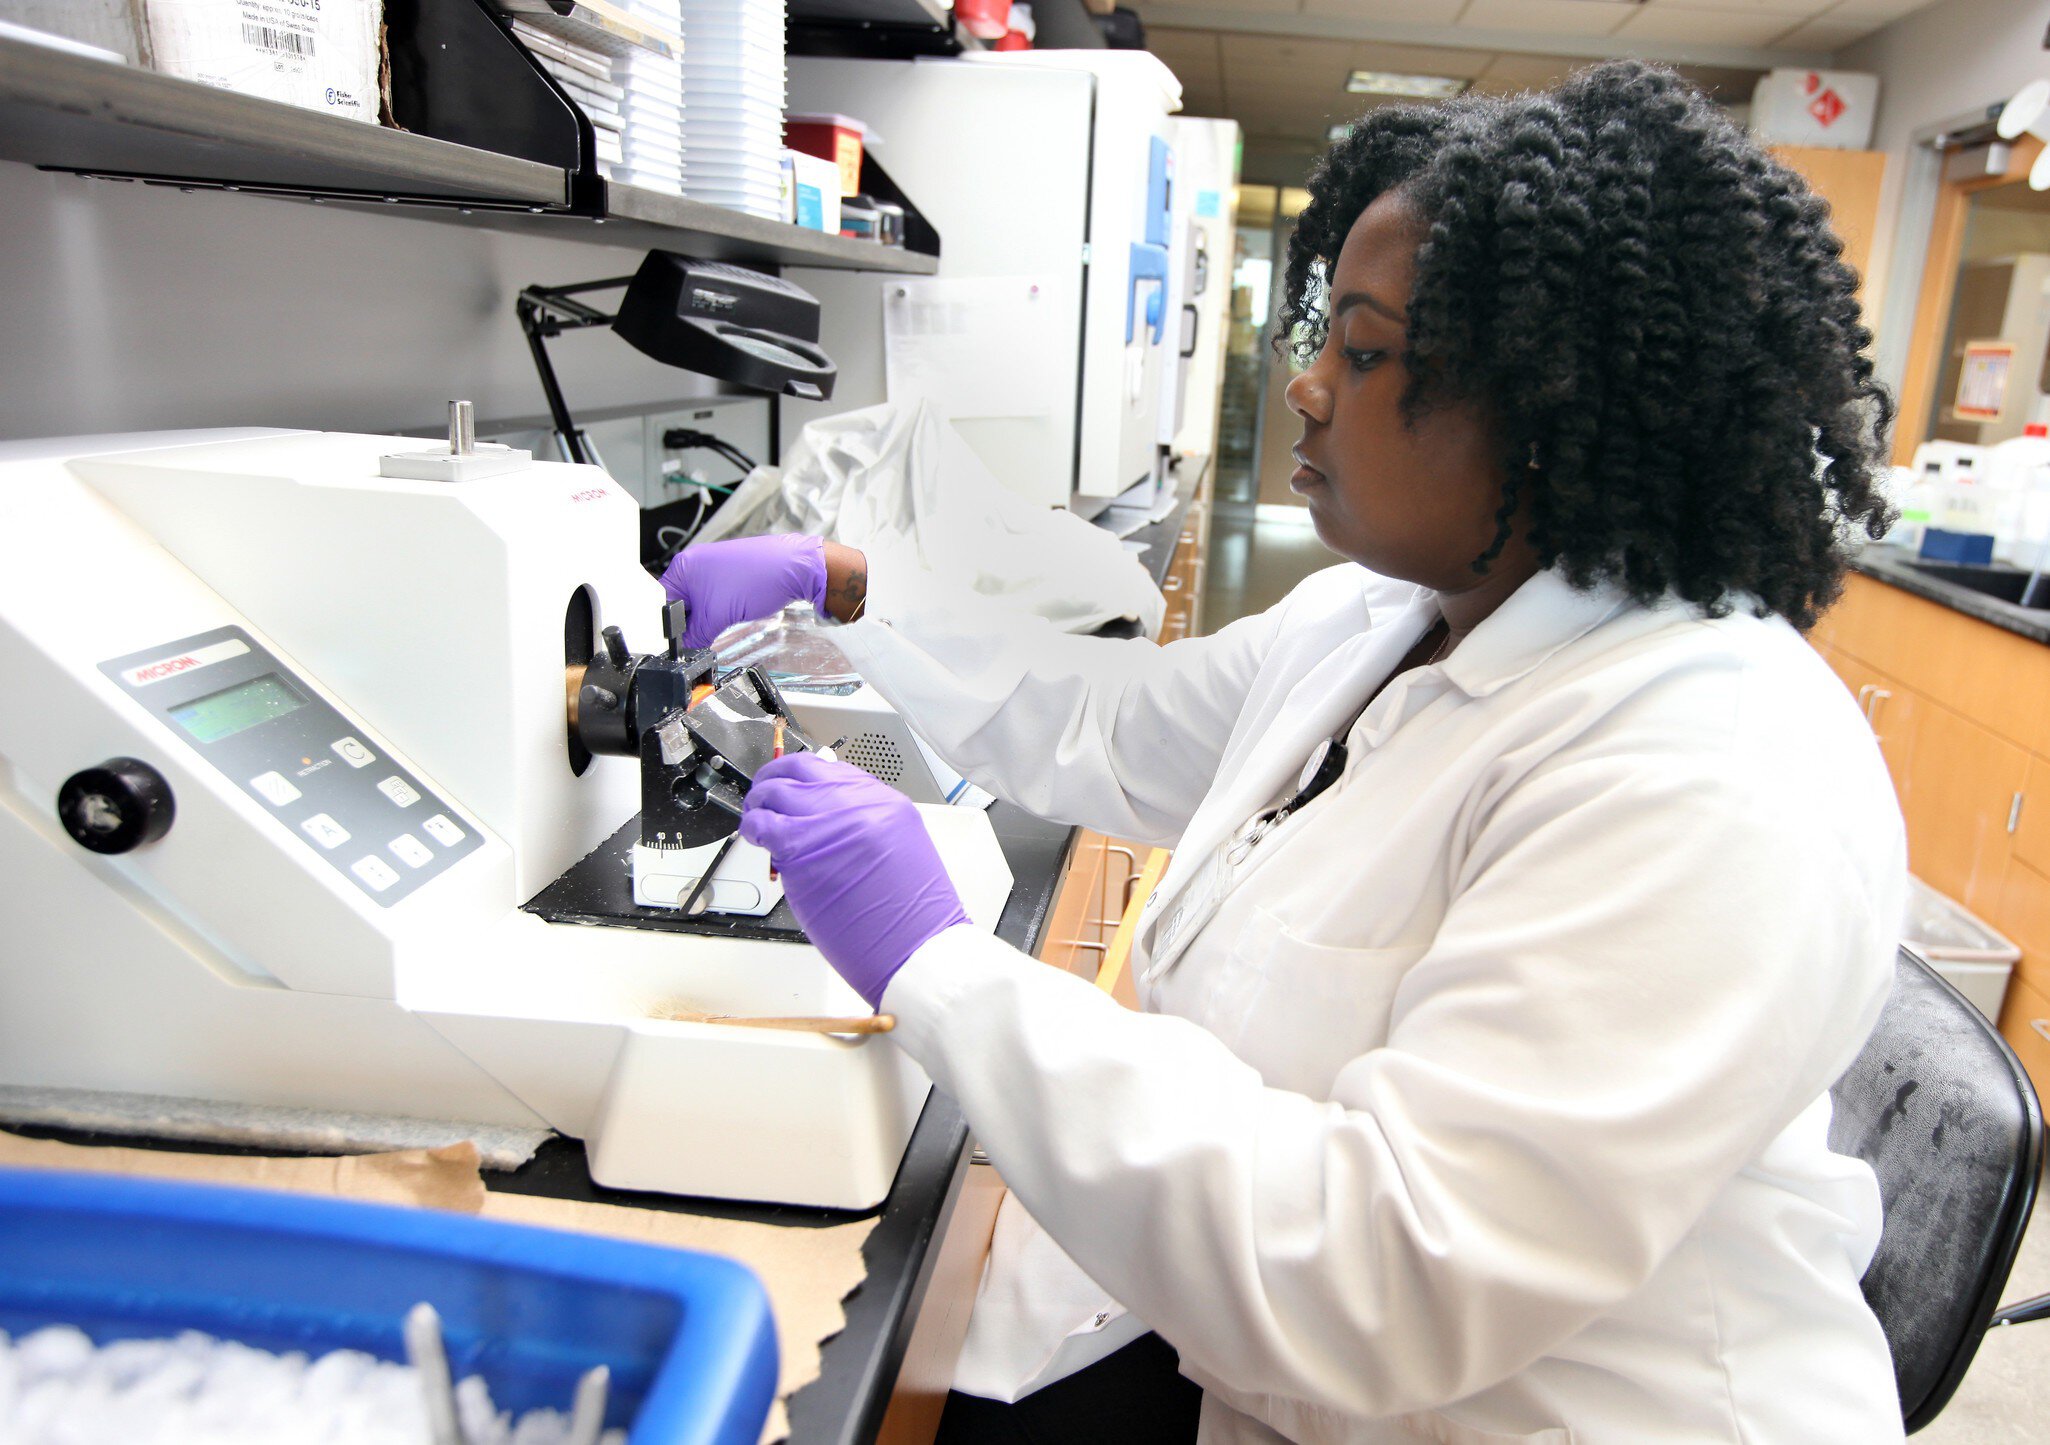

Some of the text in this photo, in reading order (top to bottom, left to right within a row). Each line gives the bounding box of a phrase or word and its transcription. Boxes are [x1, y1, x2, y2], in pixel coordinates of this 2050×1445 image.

[242, 11, 259, 21] Made
[260, 15, 266, 23] in
[266, 17, 279, 25] USA
[285, 20, 301, 31] Swiss
[337, 98, 361, 108] Scientific
[571, 488, 609, 503] MICROM
[136, 656, 202, 683] MICROM
[297, 759, 332, 778] RETRACTION
[656, 831, 683, 841] 10 0
